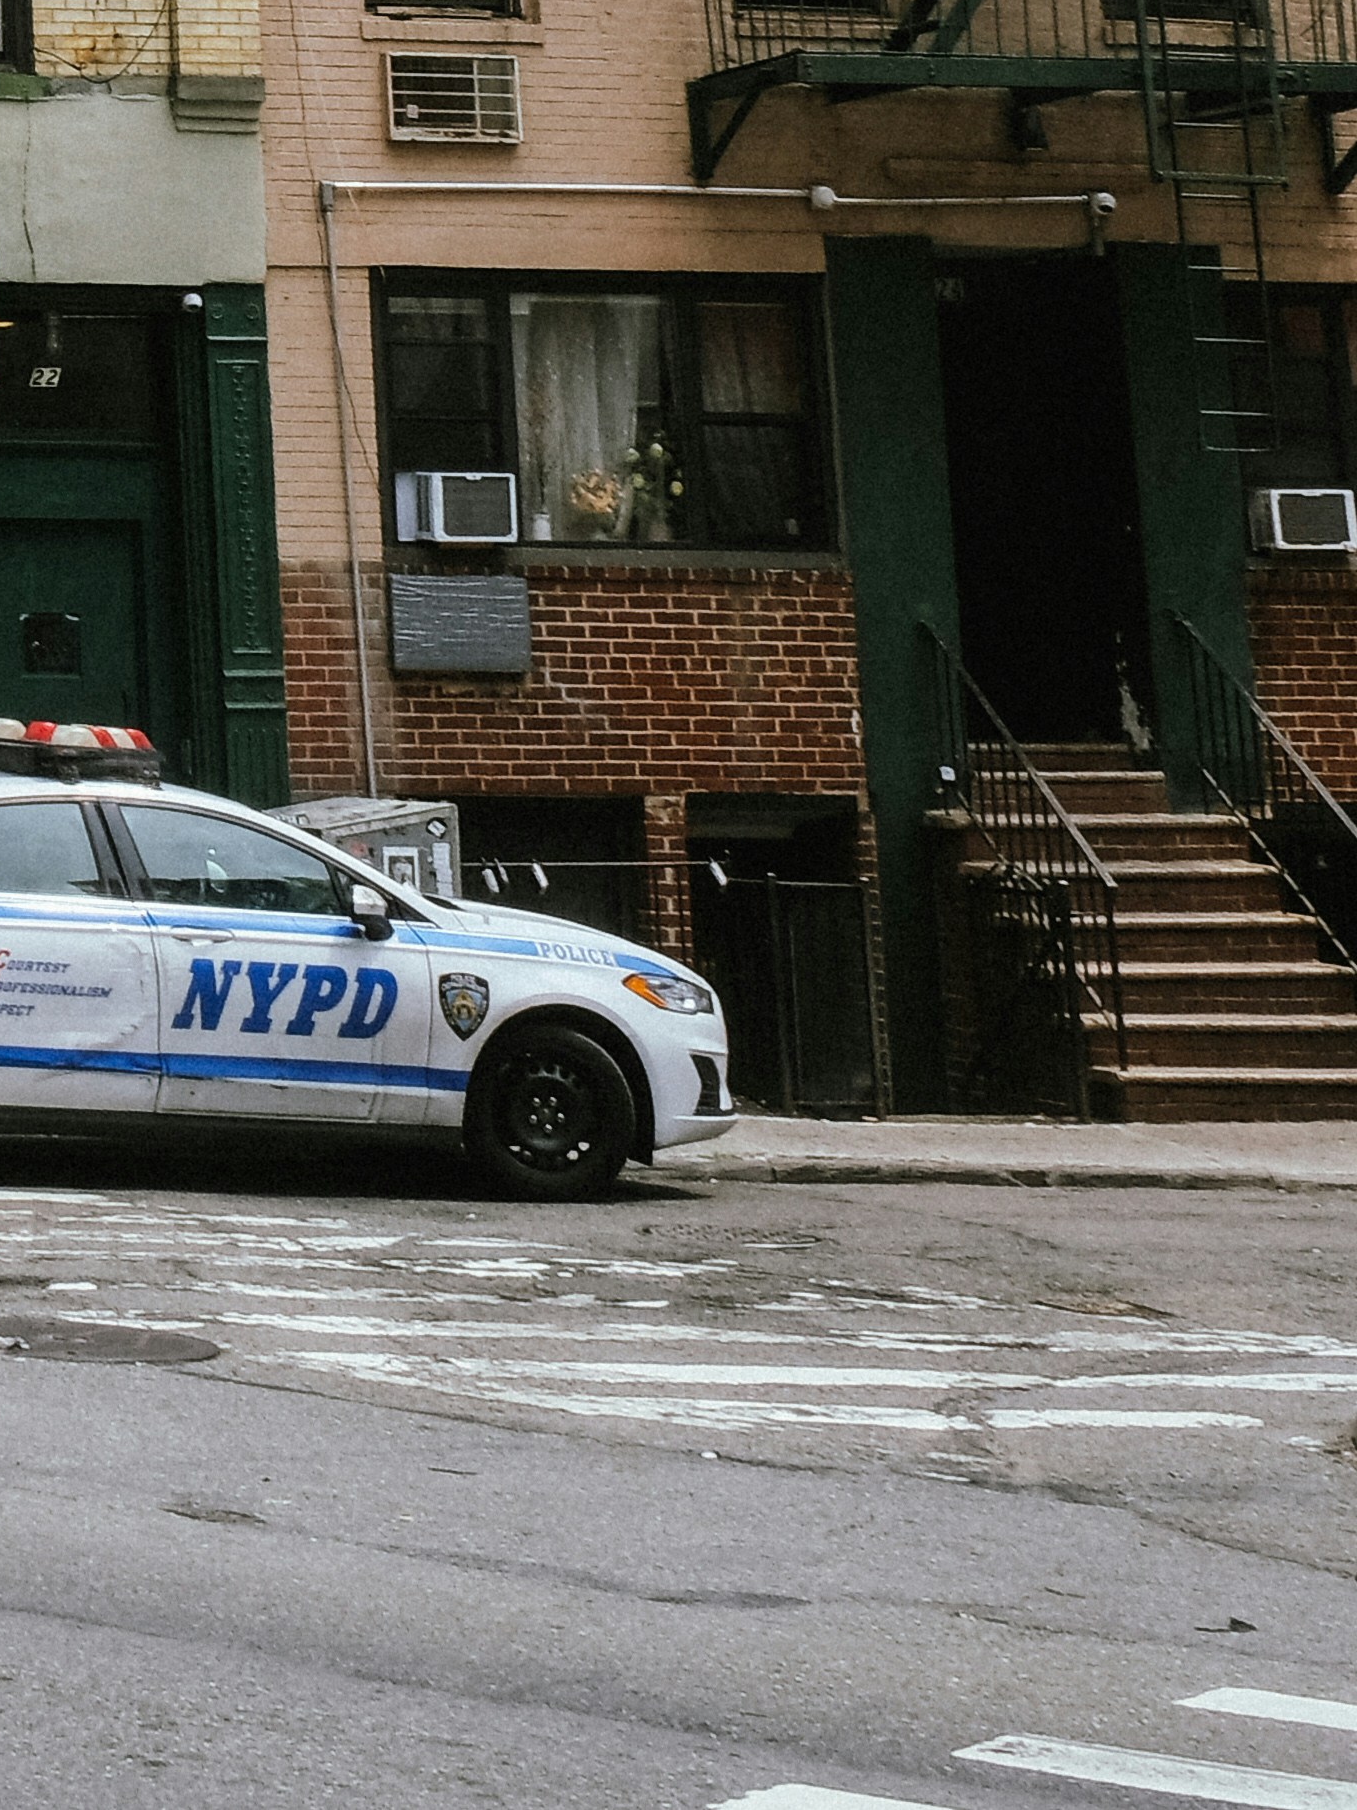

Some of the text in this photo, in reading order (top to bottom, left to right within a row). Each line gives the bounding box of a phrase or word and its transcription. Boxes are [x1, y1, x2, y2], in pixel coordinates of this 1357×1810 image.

[31, 369, 58, 386] 22
[538, 941, 616, 967] POLICE
[171, 958, 399, 1040] NYPD
